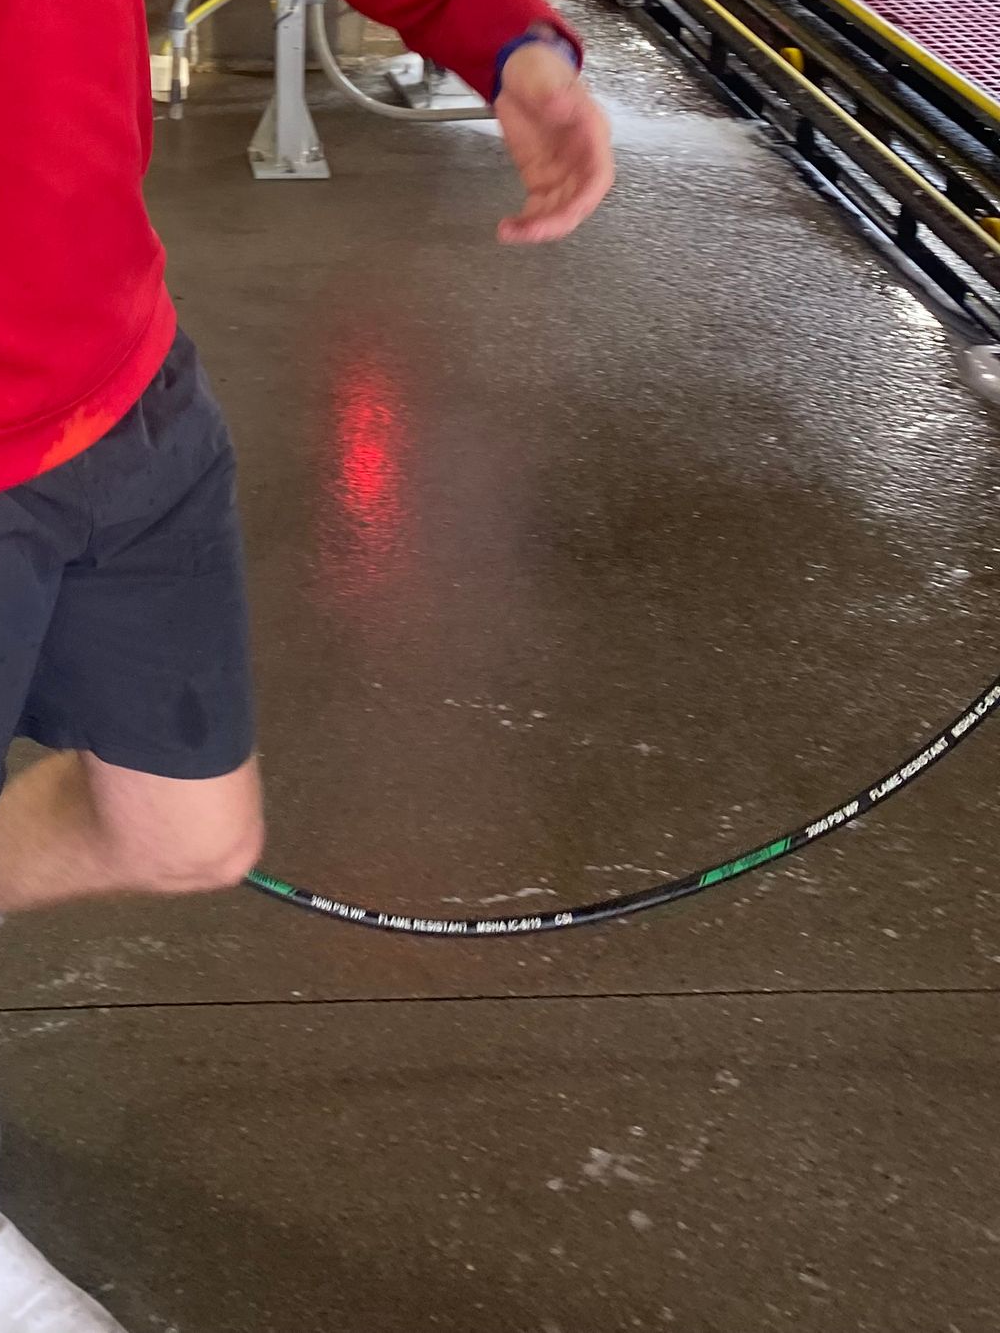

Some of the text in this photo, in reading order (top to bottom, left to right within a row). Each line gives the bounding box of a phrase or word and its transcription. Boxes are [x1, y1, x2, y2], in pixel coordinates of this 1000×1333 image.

[869, 773, 903, 802] FLAME
[900, 736, 949, 780] RESISTANT
[378, 913, 412, 930] FLAME
[412, 918, 467, 933] RESISTANT
